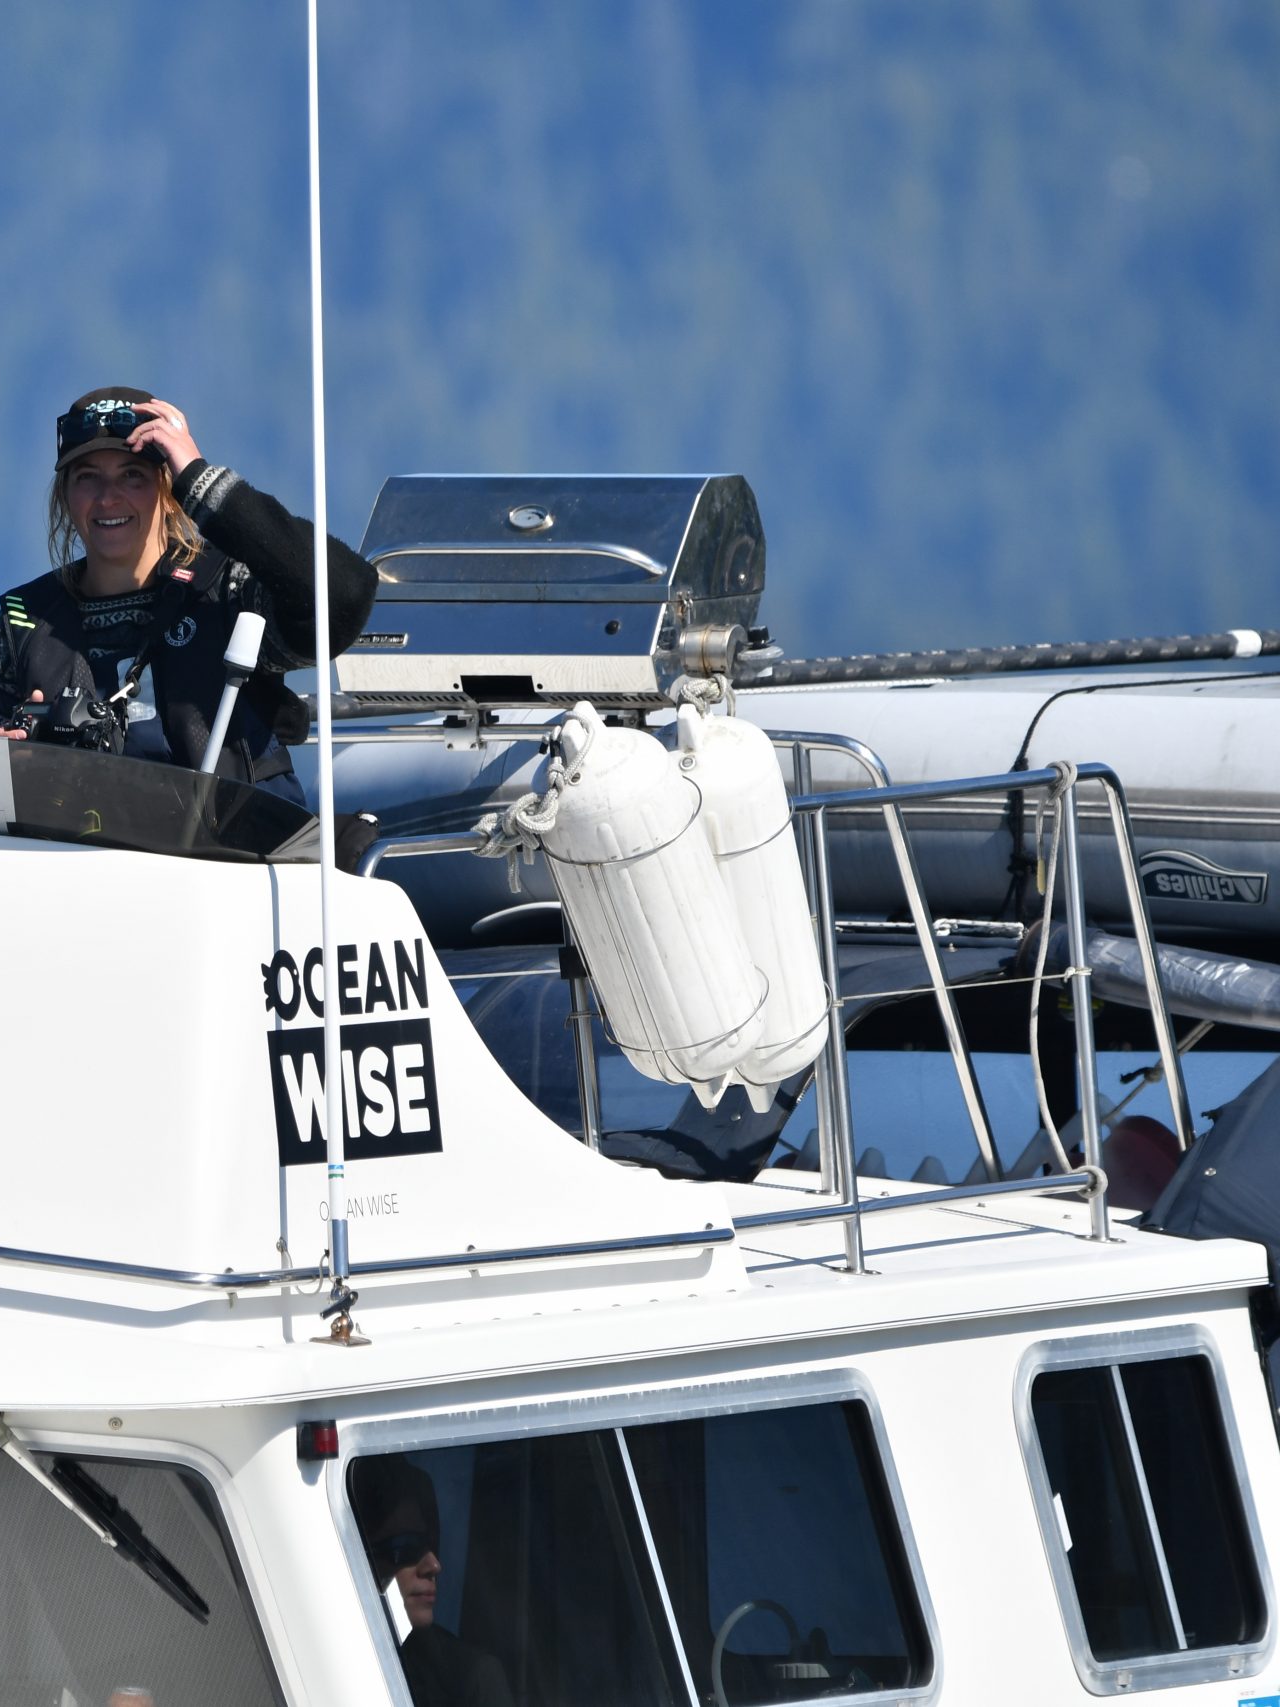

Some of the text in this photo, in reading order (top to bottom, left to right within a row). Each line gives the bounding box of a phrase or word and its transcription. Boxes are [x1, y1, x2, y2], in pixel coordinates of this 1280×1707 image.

[1155, 873, 1261, 904] Achilles
[261, 938, 429, 1021] OCEAN
[279, 1043, 431, 1142] WISE
[319, 1193, 400, 1222] OAN WISE
